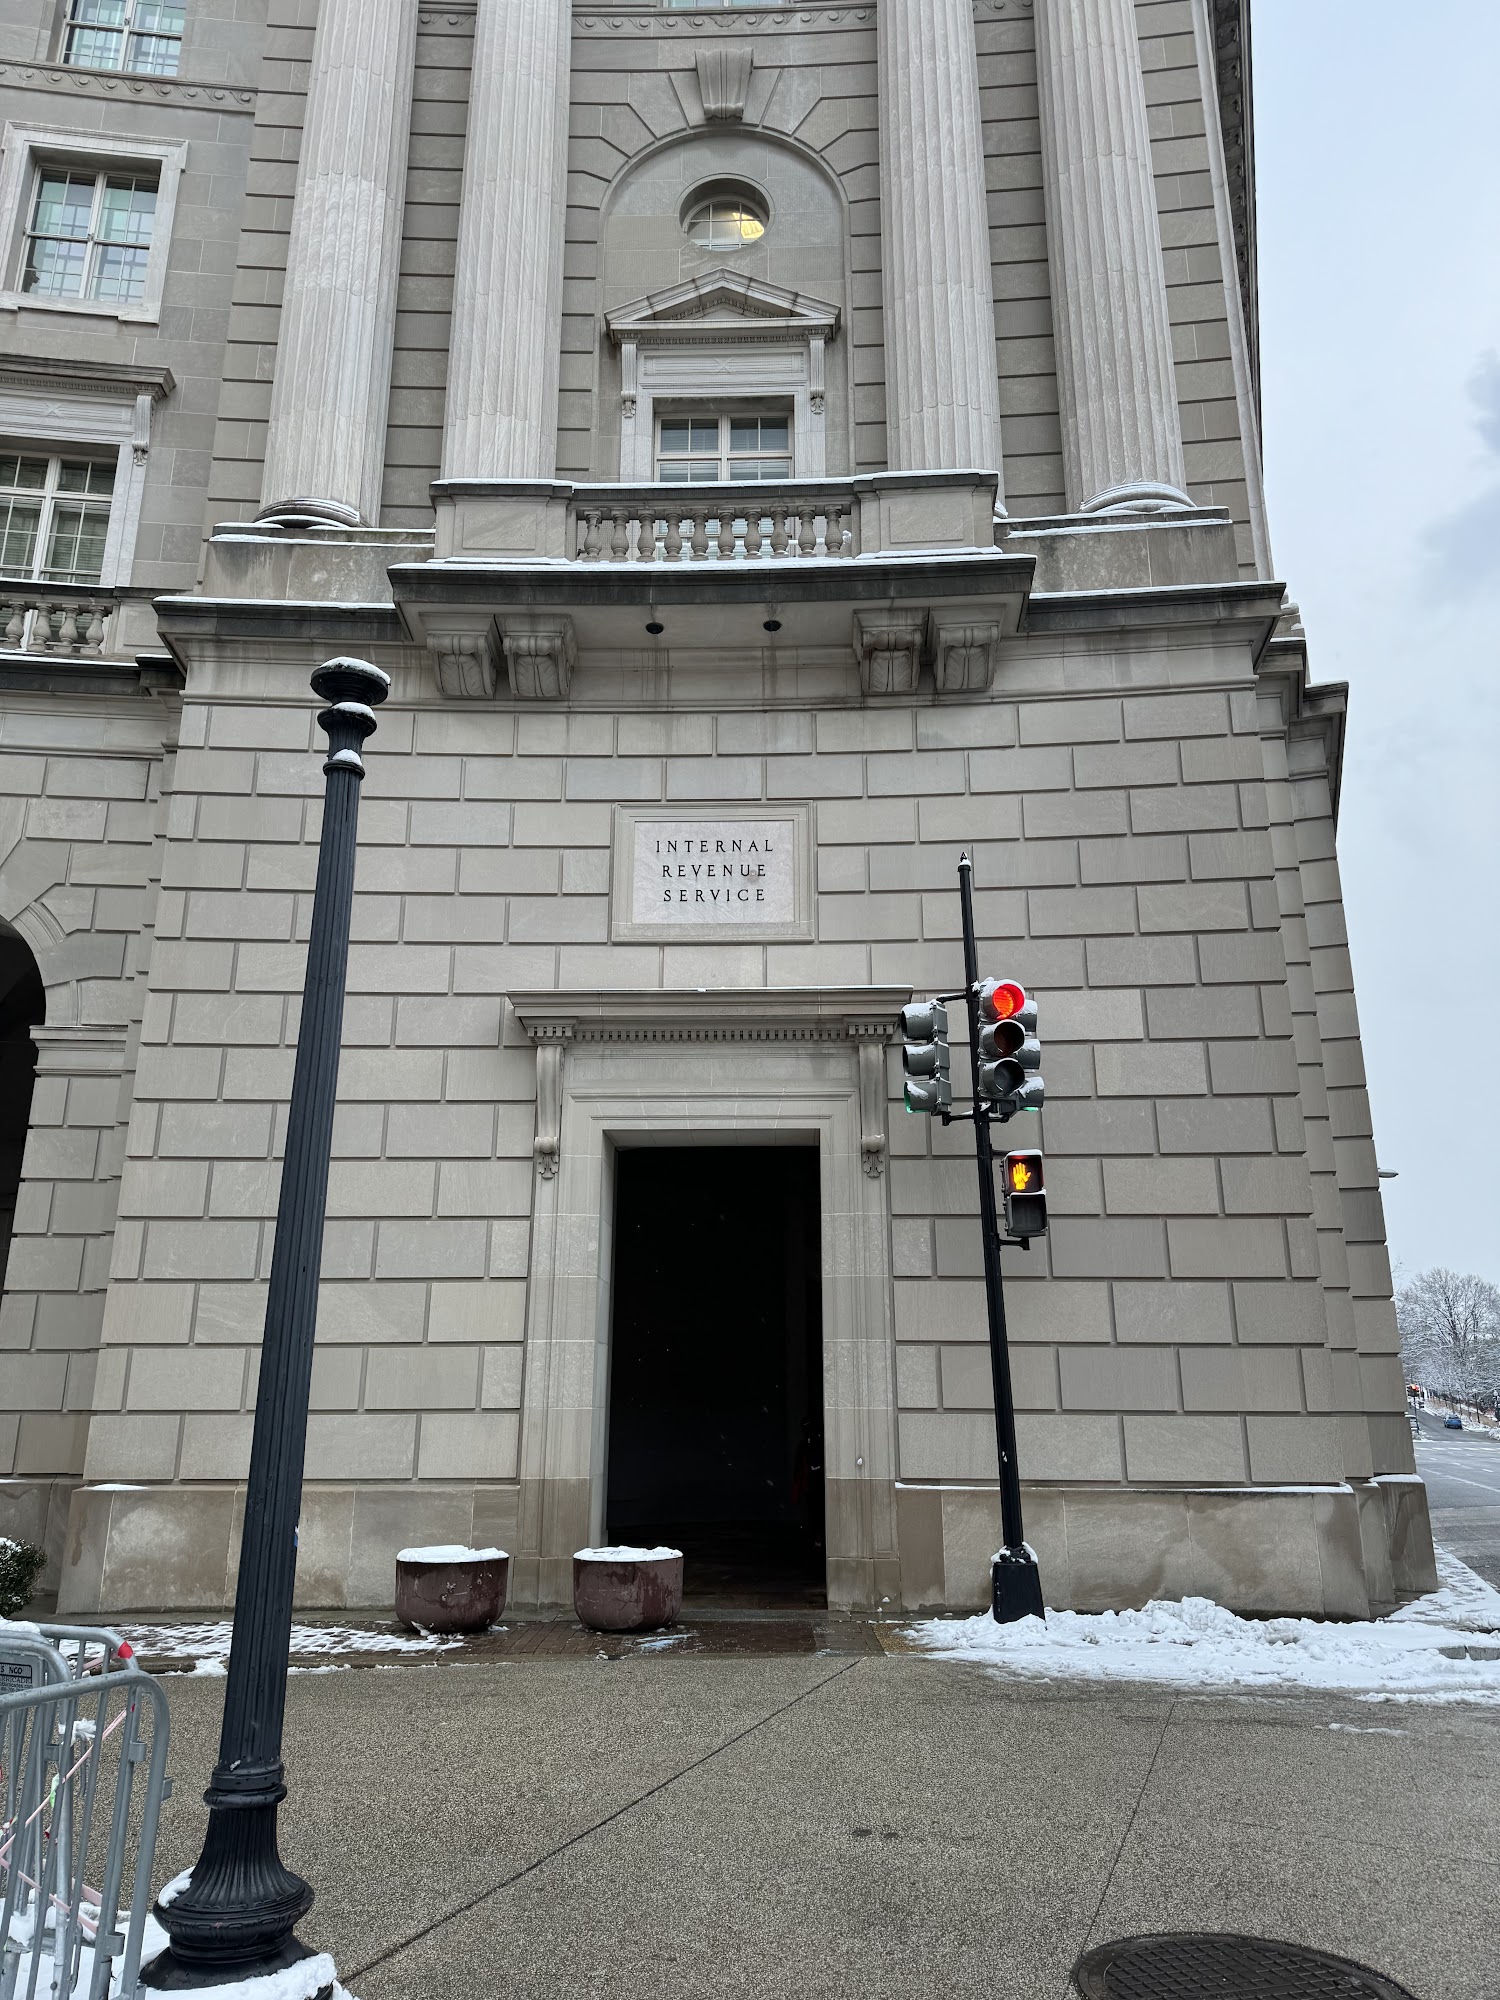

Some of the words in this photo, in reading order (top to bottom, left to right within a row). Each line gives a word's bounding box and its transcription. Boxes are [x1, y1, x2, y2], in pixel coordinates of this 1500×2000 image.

[656, 839, 774, 853] INTERNAL
[662, 864, 766, 878] REVENUE
[663, 888, 765, 903] SERVICE
